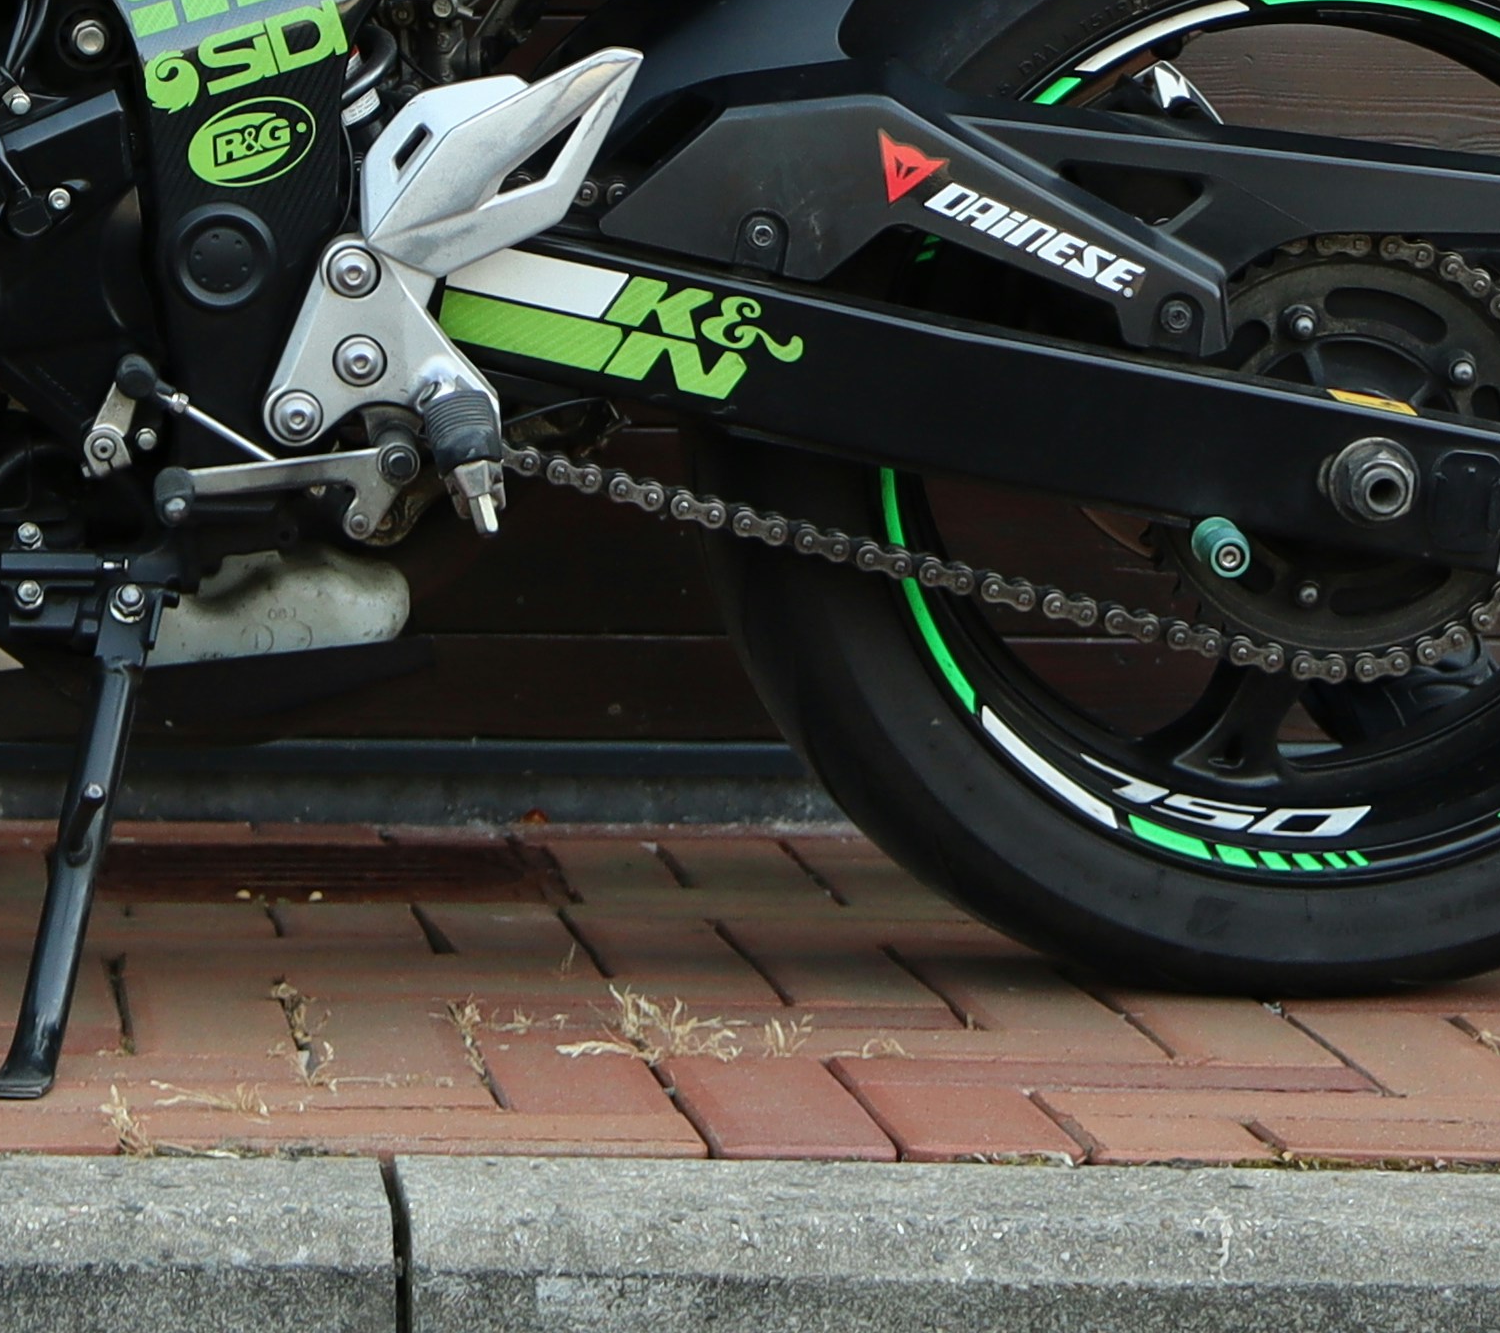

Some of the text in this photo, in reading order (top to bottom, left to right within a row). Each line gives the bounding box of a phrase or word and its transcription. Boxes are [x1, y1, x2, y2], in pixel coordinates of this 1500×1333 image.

[214, 117, 291, 165] R&G
[923, 181, 1146, 295] DAINESE
[1081, 753, 1372, 837] 750
